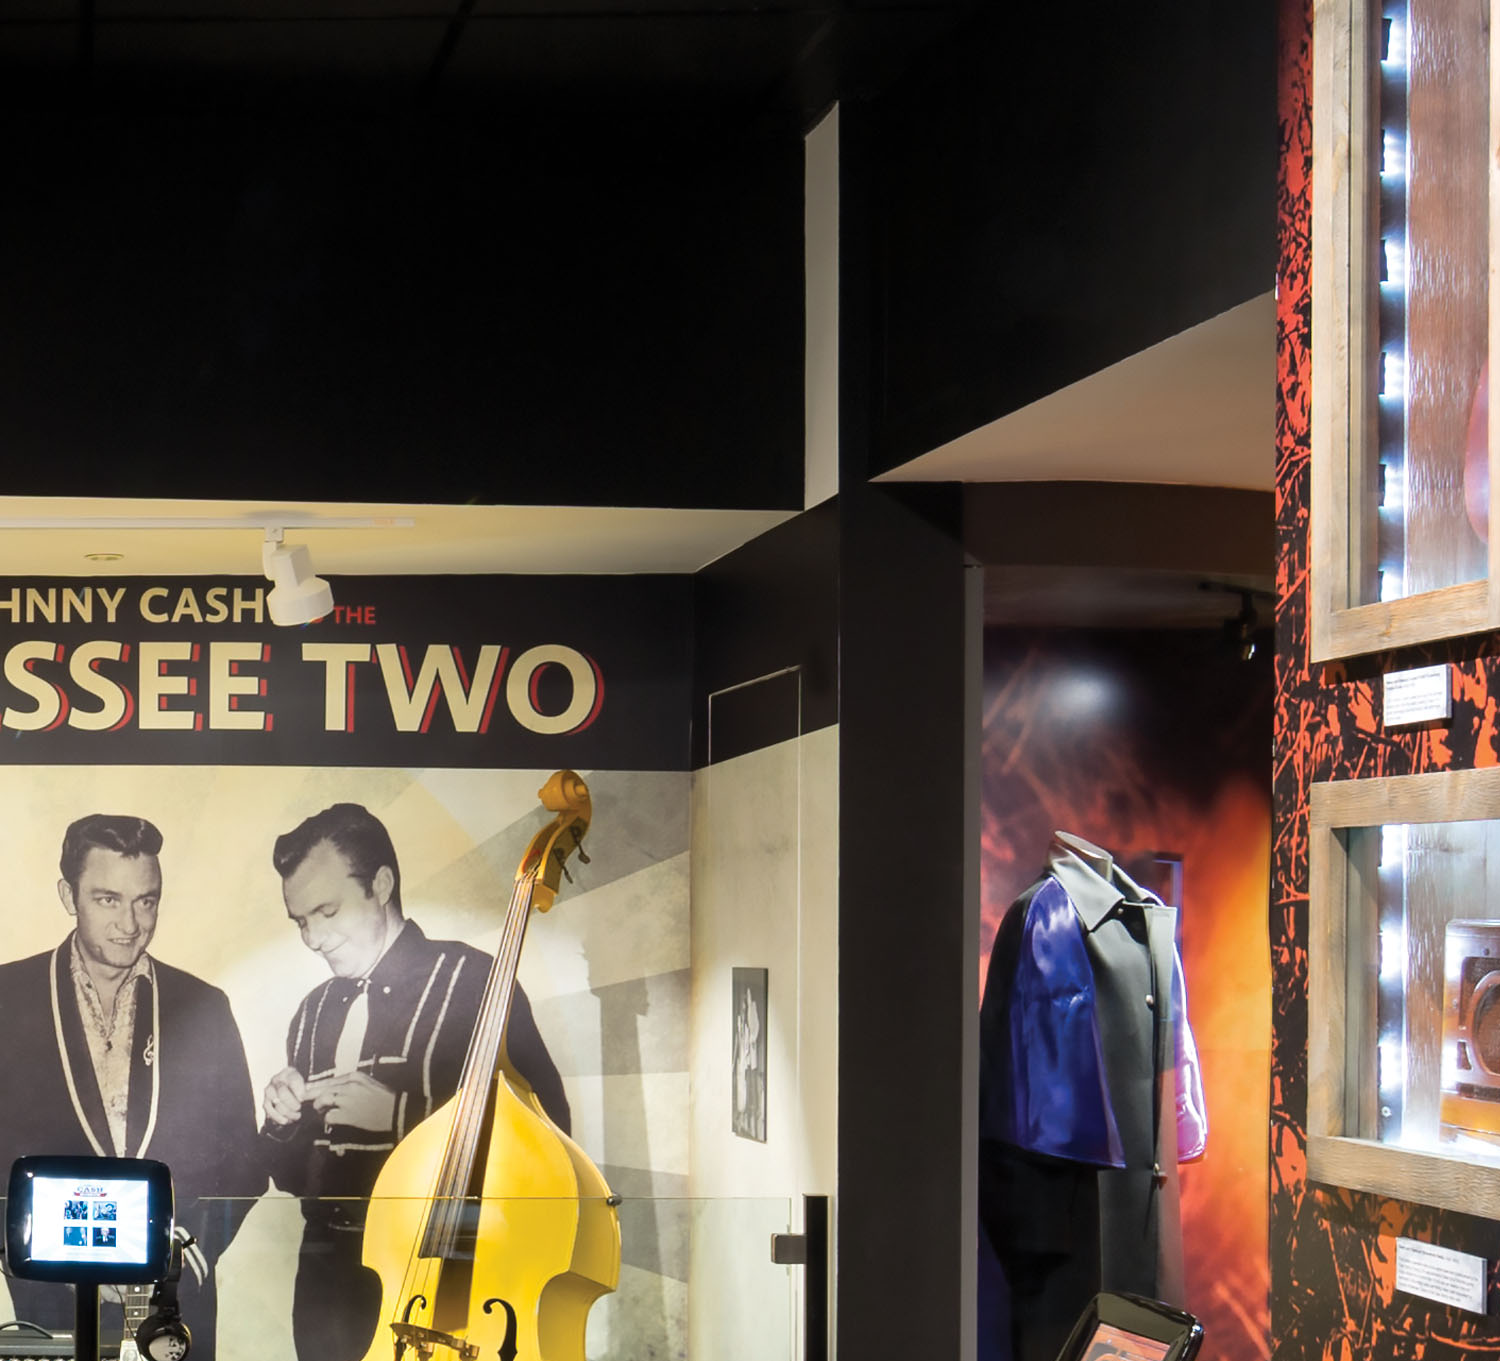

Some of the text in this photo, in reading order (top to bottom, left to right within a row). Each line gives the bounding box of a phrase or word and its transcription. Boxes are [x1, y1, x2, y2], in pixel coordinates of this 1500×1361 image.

[139, 587, 264, 624] CASH
[333, 605, 376, 625] THE
[300, 641, 605, 736] TWO
